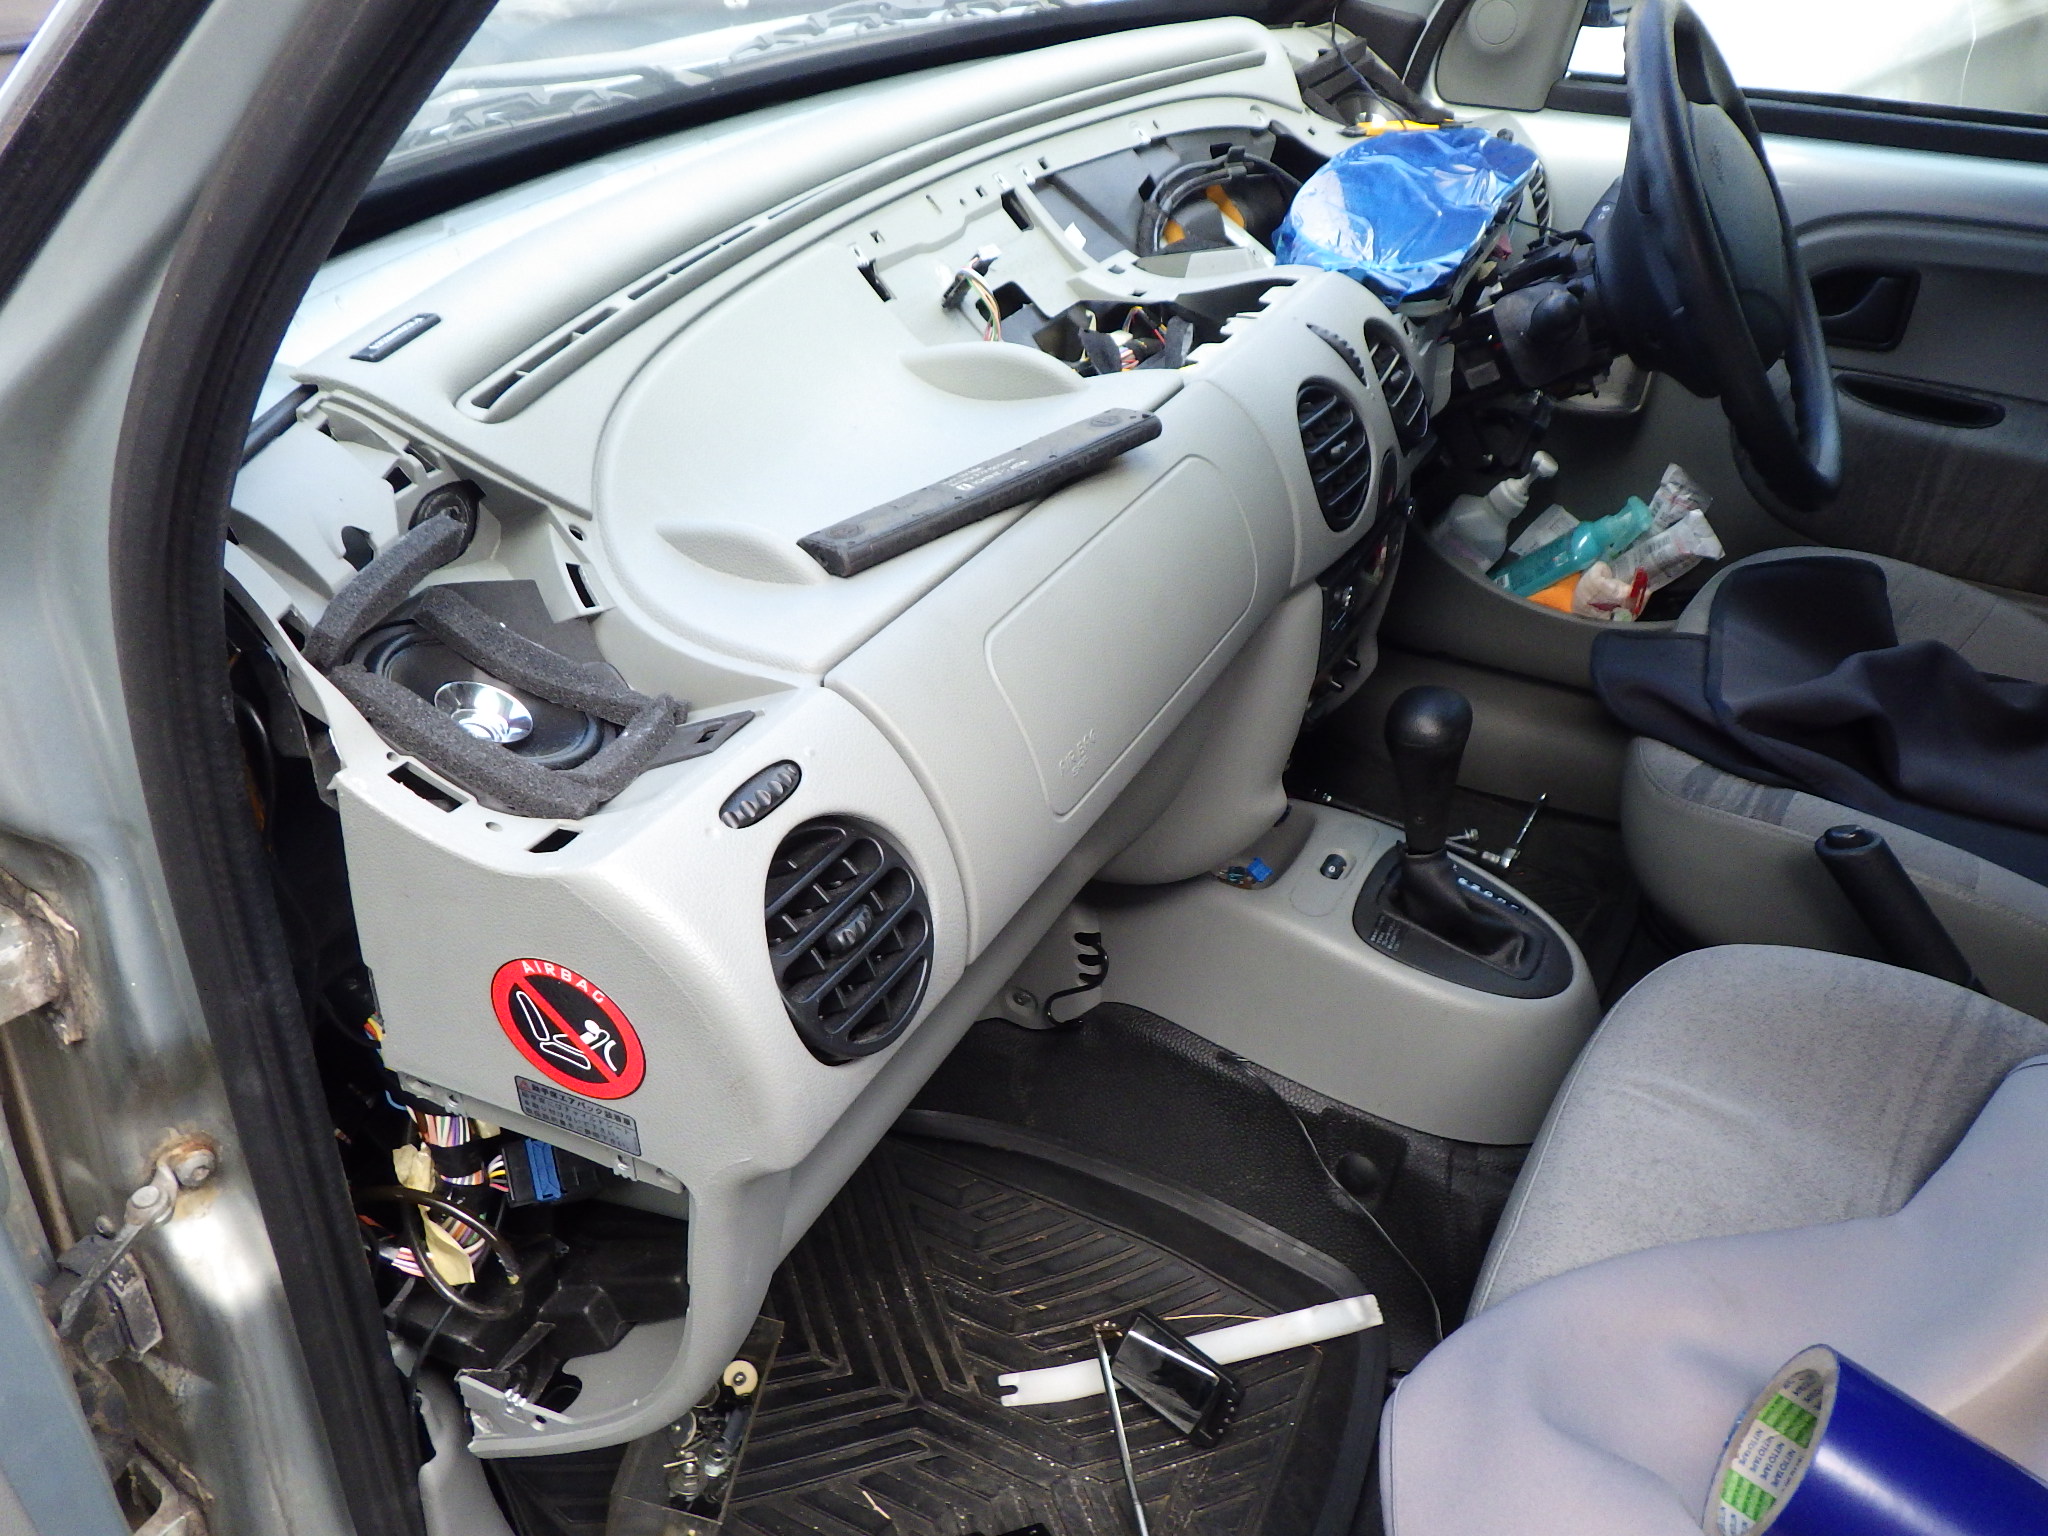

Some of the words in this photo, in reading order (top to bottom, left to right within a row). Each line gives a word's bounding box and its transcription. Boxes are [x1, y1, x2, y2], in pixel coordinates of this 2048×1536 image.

[521, 960, 606, 1003] AIRBAG
[1768, 1441, 1785, 1464] NITTO
[1779, 1448, 1797, 1471] NITTO
[1759, 1462, 1774, 1481] TAPE
